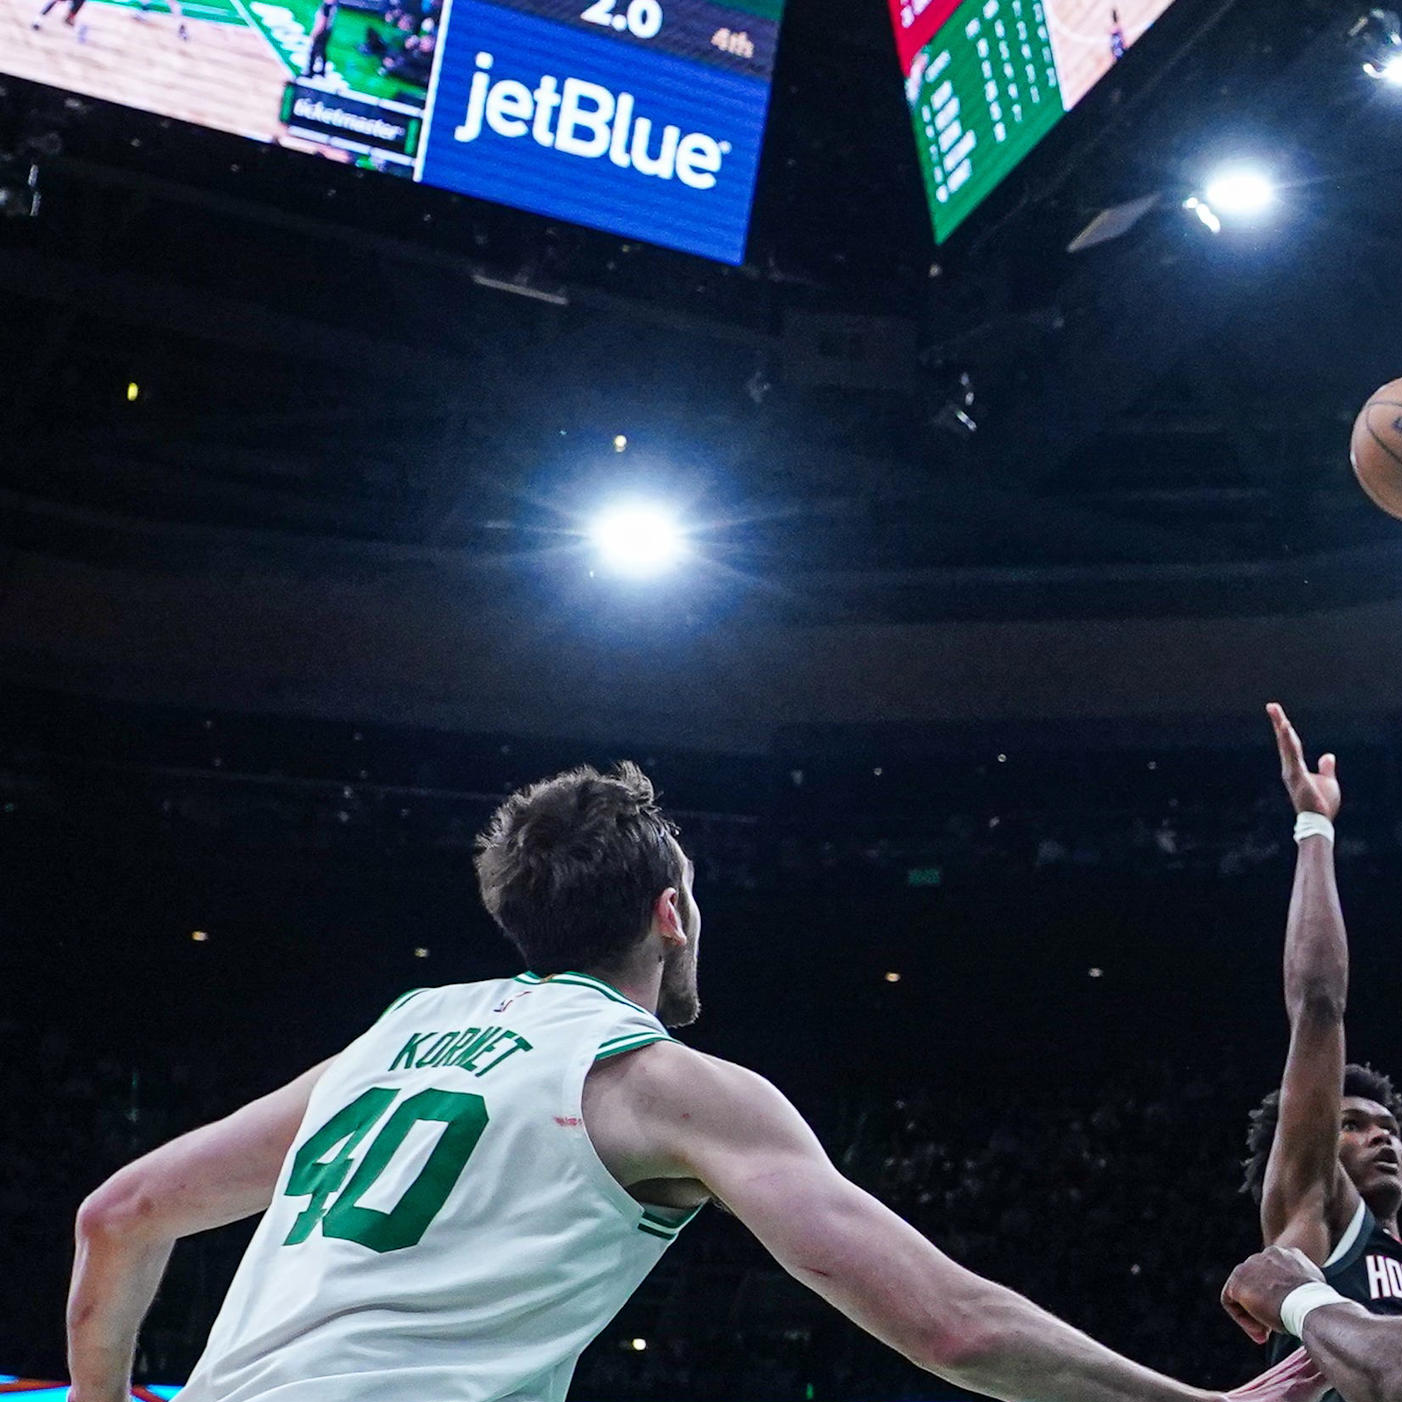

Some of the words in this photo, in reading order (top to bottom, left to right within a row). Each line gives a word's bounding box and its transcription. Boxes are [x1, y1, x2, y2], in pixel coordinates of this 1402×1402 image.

[711, 27, 754, 58] 4th
[454, 51, 733, 190] jetBlue
[388, 1026, 533, 1078] KORNET
[283, 1086, 490, 1254] 40
